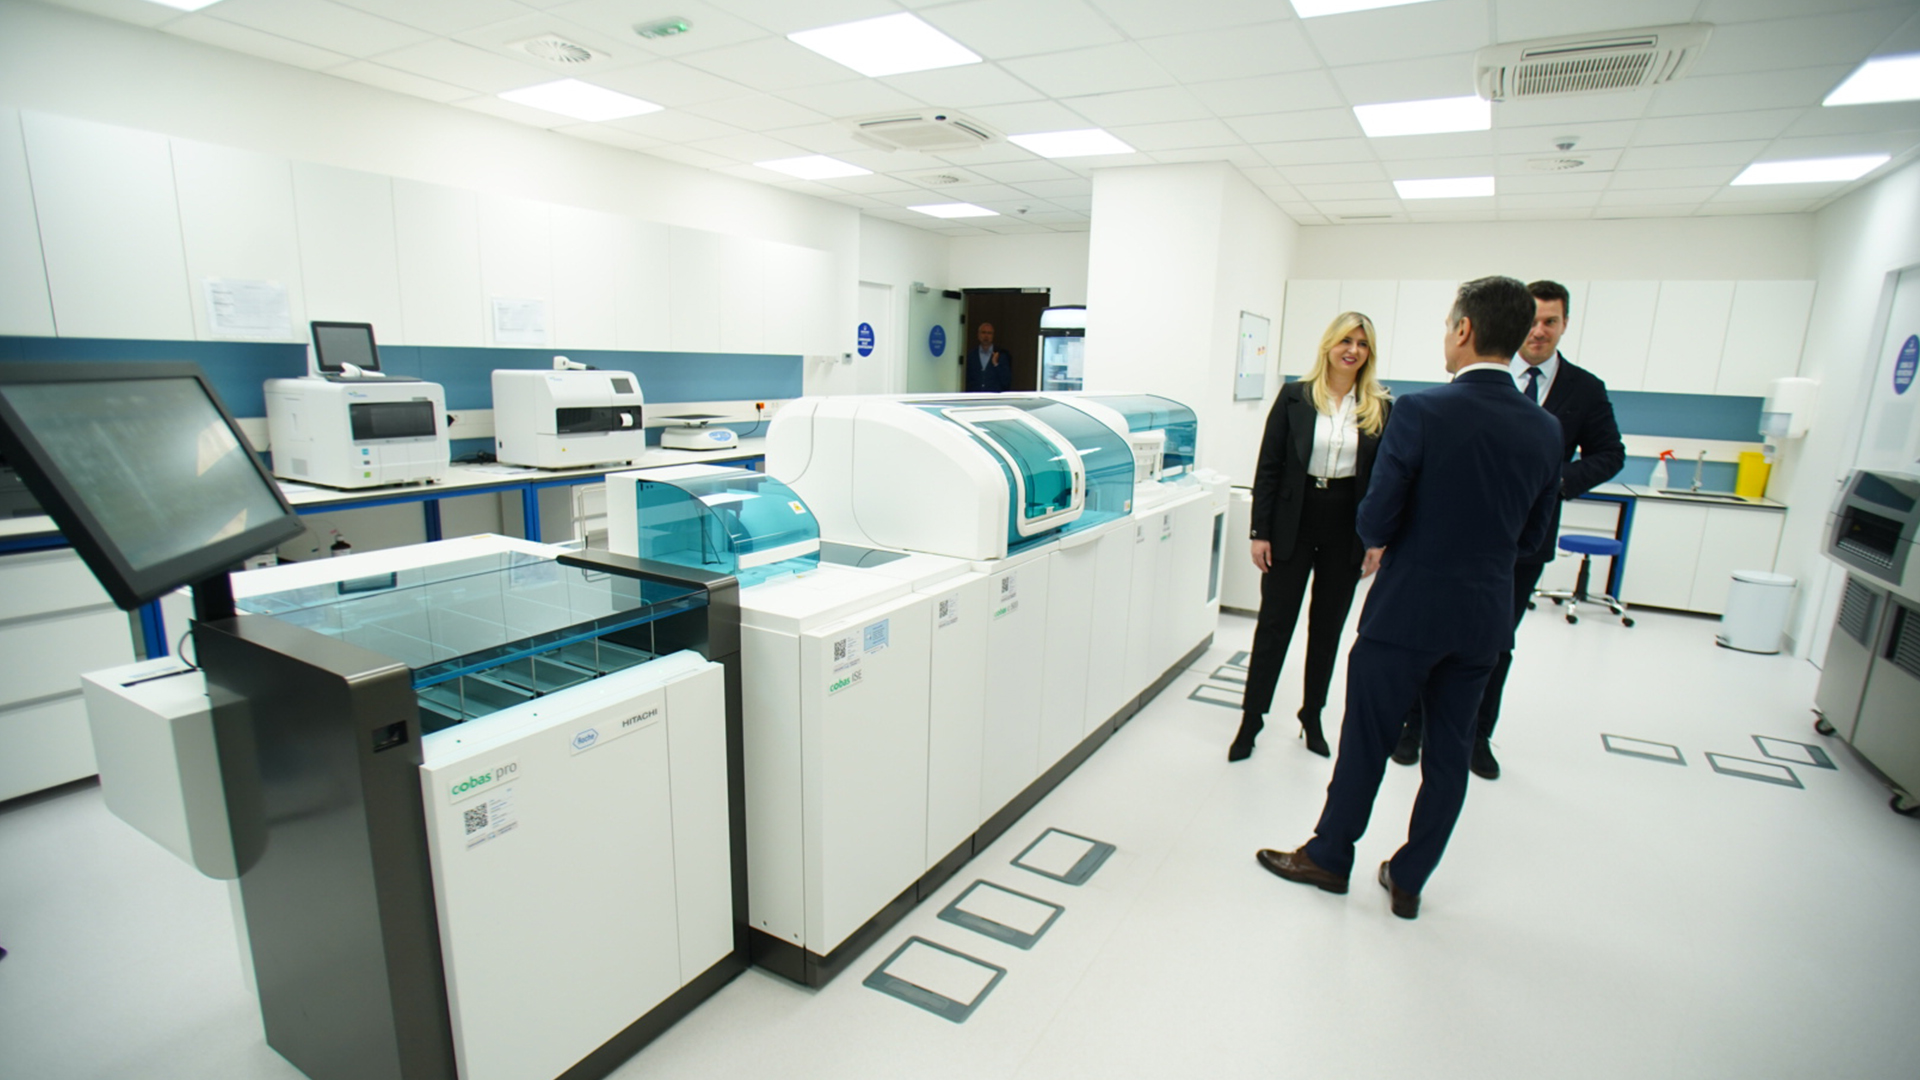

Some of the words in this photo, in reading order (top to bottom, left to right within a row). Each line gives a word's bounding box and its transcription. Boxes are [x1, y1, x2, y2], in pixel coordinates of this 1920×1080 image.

[830, 677, 850, 692] cobas
[852, 669, 862, 682] ISE
[622, 708, 658, 727] HITACHI
[452, 772, 492, 795] cobas
[496, 762, 517, 781] pro
